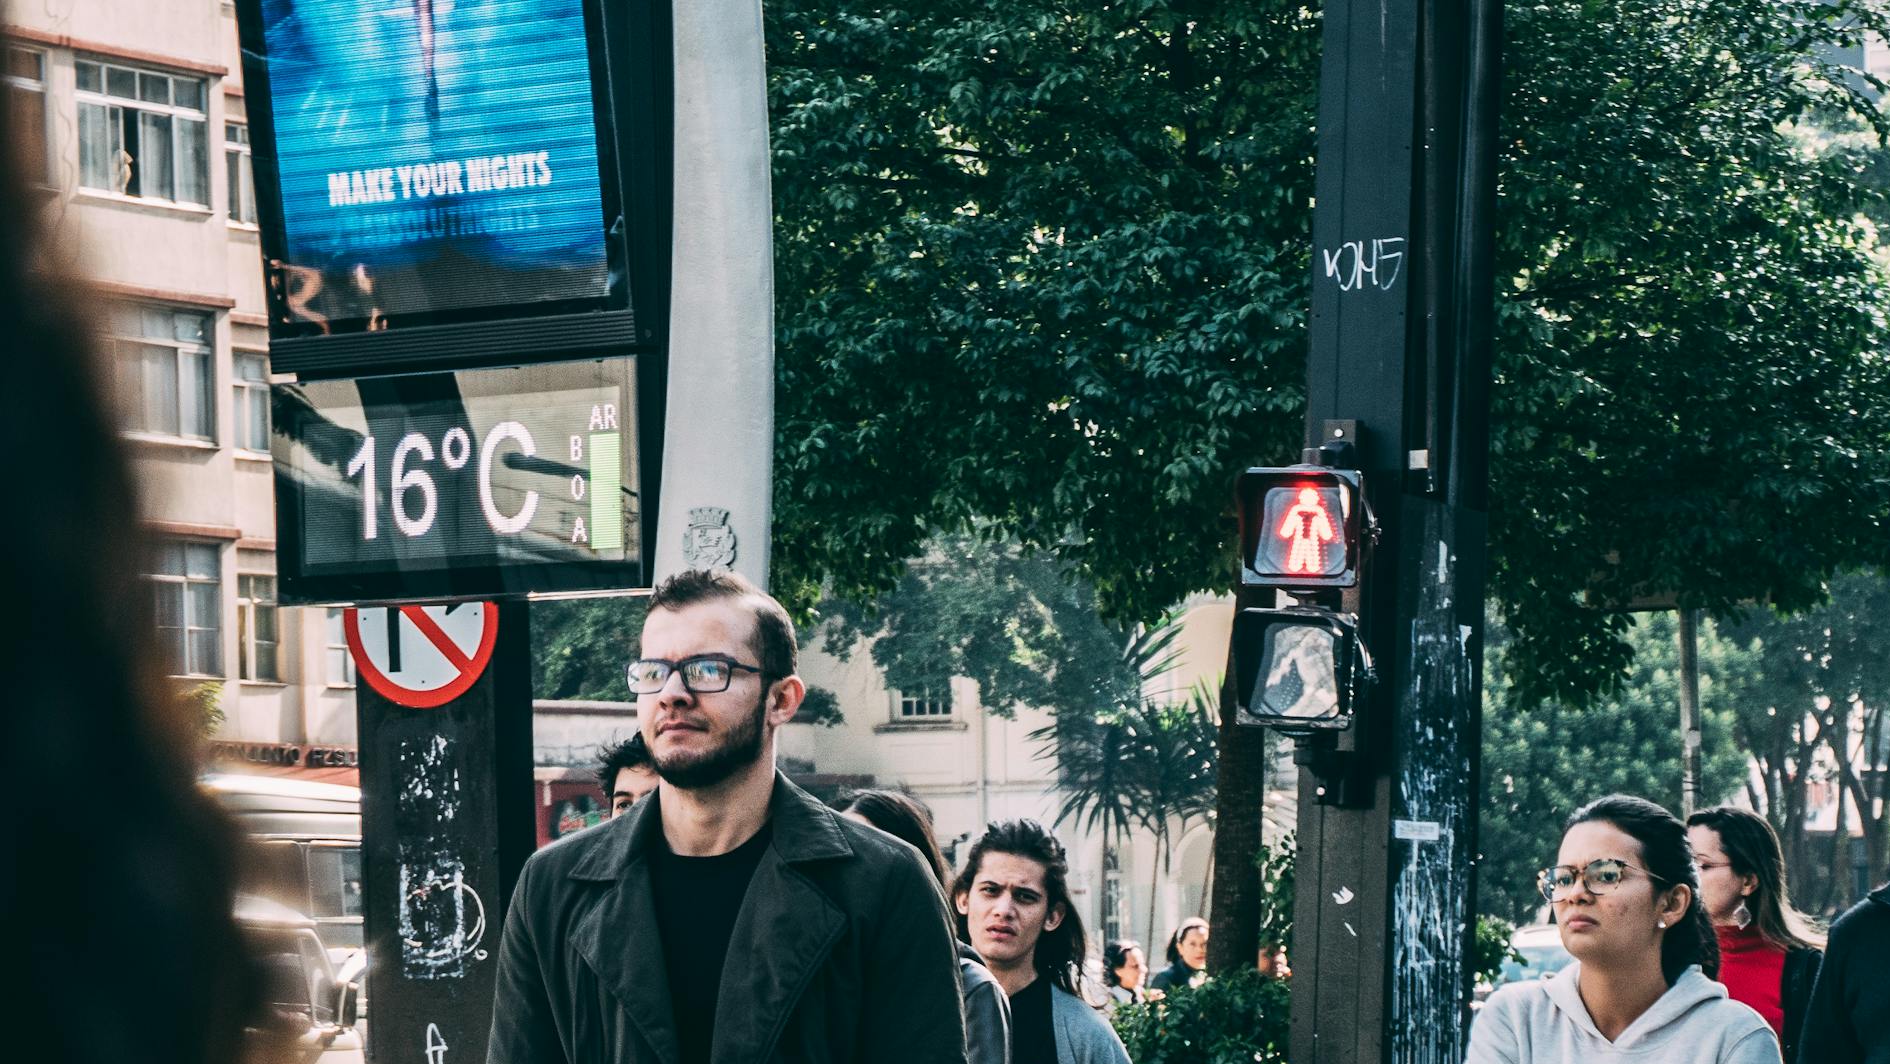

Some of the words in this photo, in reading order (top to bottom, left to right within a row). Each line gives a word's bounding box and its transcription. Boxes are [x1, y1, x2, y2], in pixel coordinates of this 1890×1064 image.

[328, 169, 396, 207] MAKE
[397, 161, 464, 199] YOUR
[466, 150, 552, 193] NIGHTS
[589, 403, 618, 431] AR
